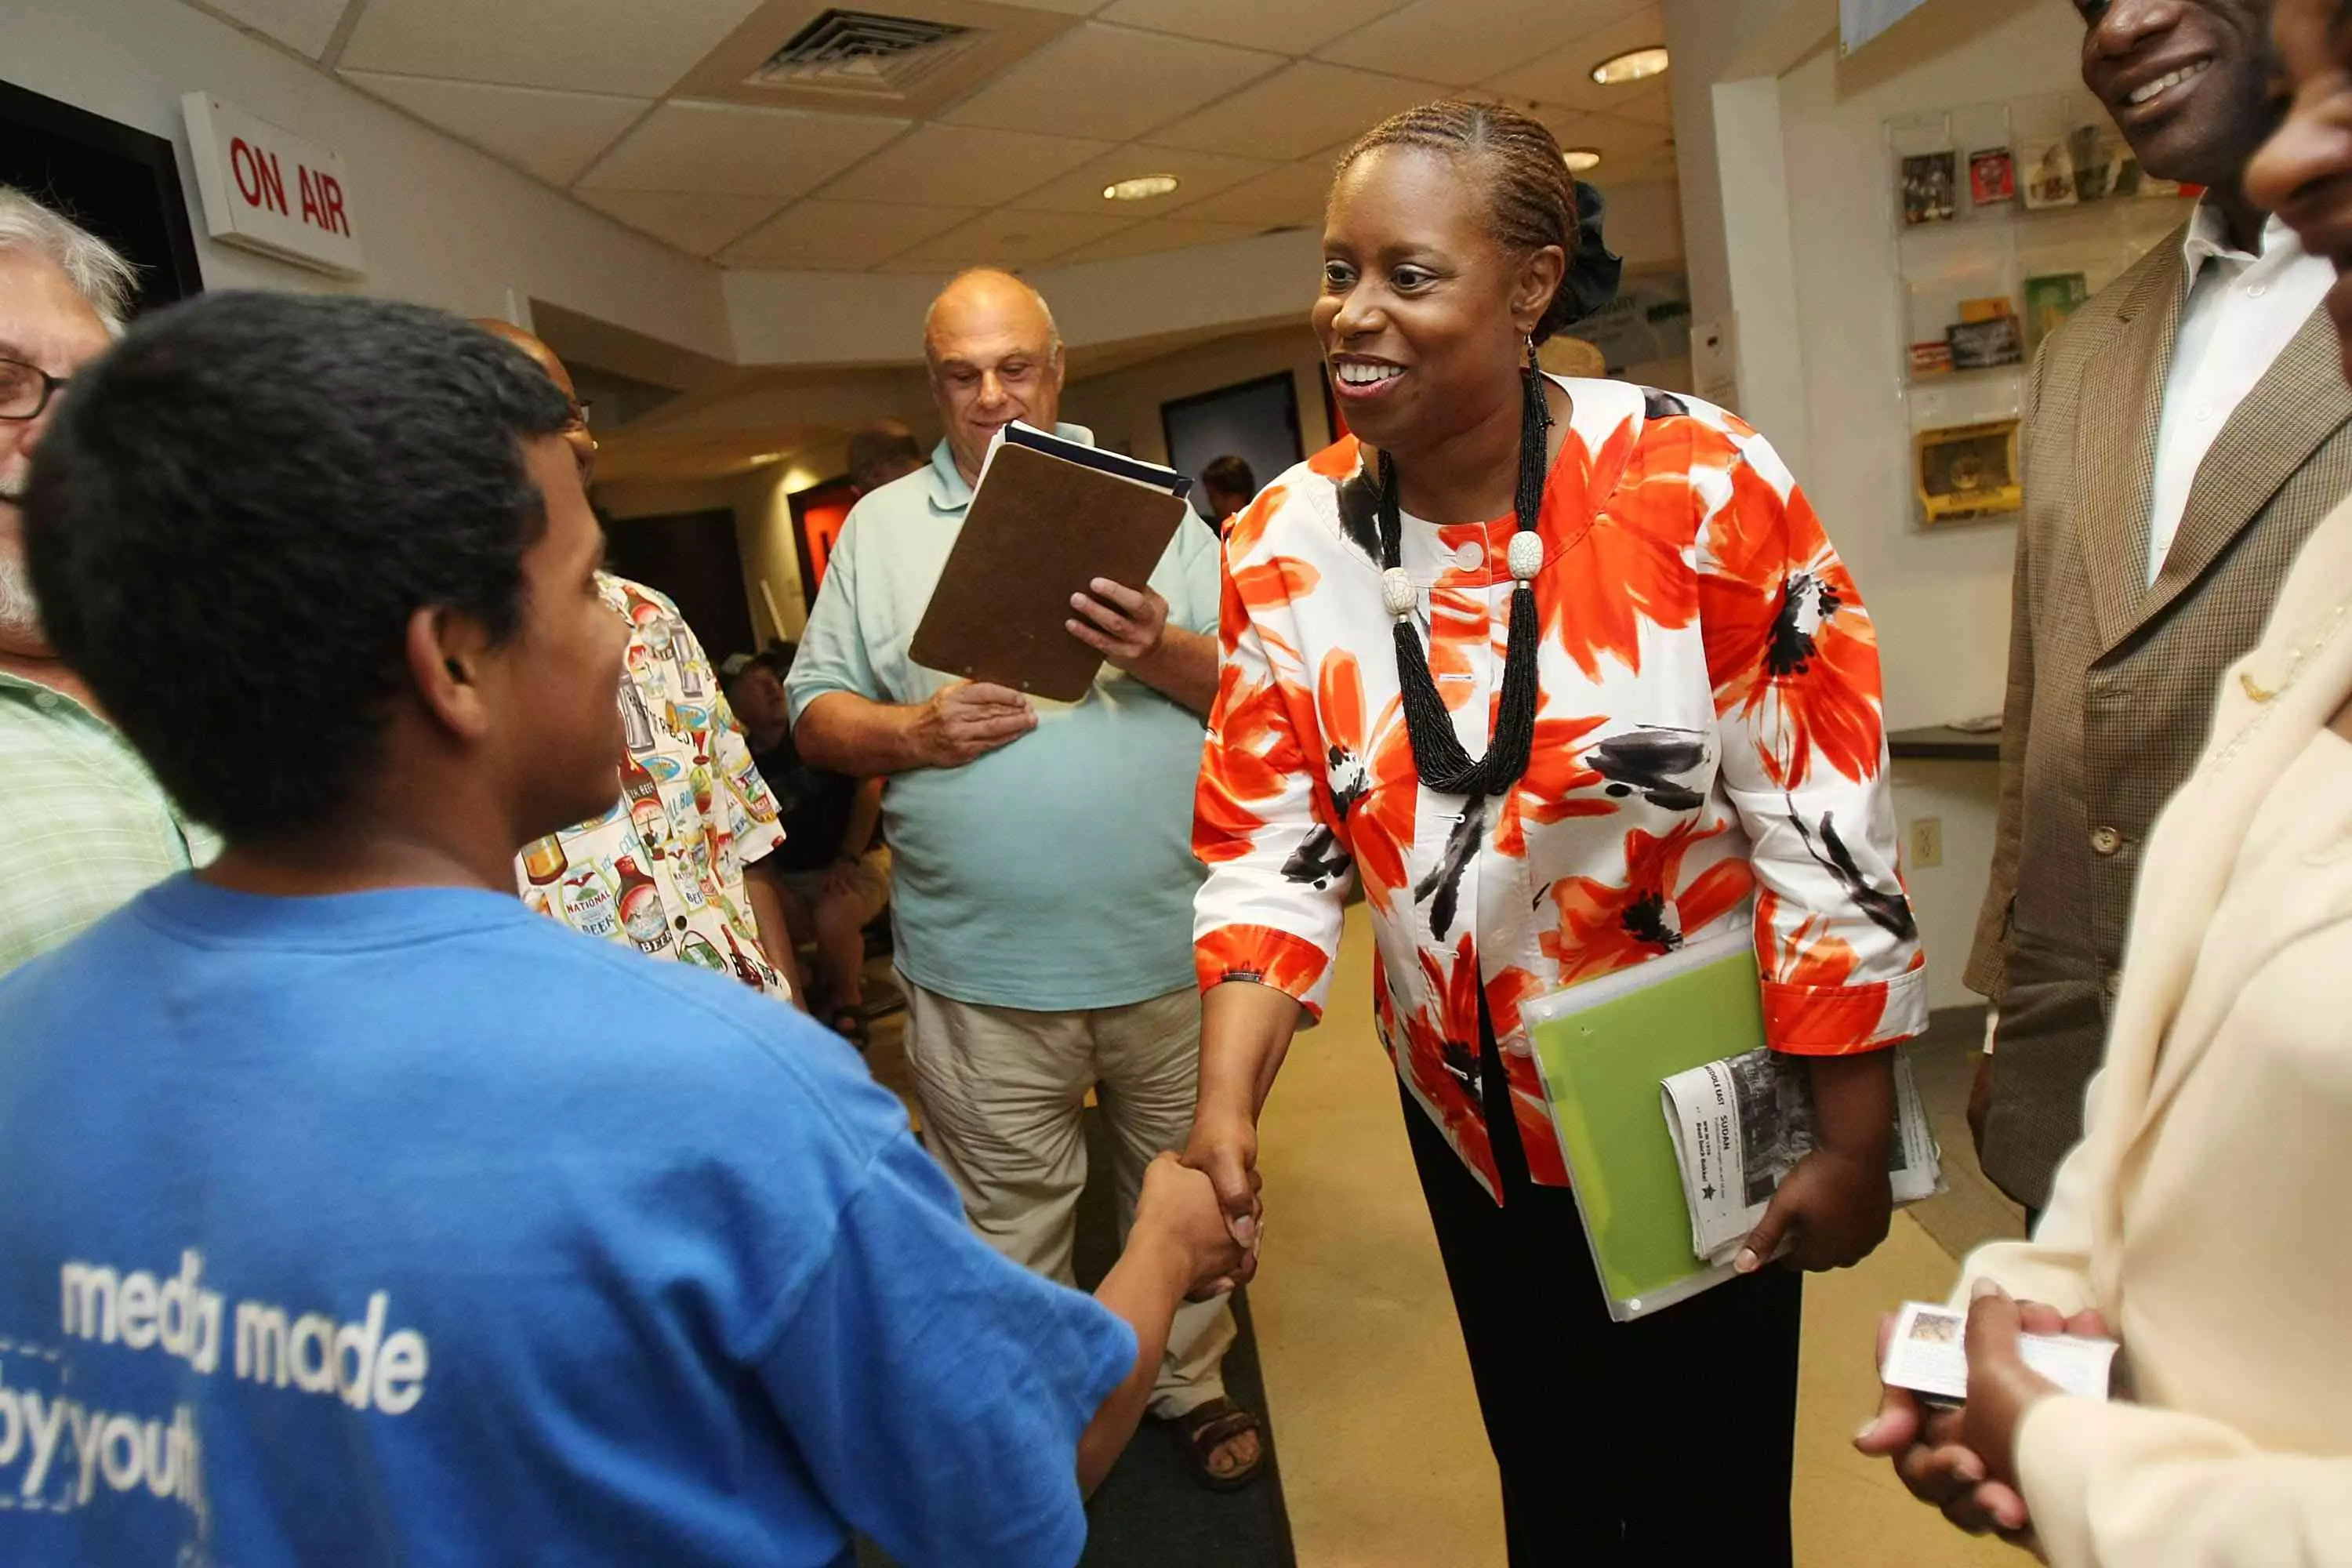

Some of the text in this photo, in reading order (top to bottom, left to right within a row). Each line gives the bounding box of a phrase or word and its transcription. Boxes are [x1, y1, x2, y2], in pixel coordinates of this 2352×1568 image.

[230, 136, 350, 238] ON AIR
[566, 890, 612, 914] NATIONAL
[582, 914, 615, 936] BEER
[640, 929, 673, 953] BEER
[1720, 1115, 1730, 1150] SUDAN
[236, 1290, 427, 1414] made
